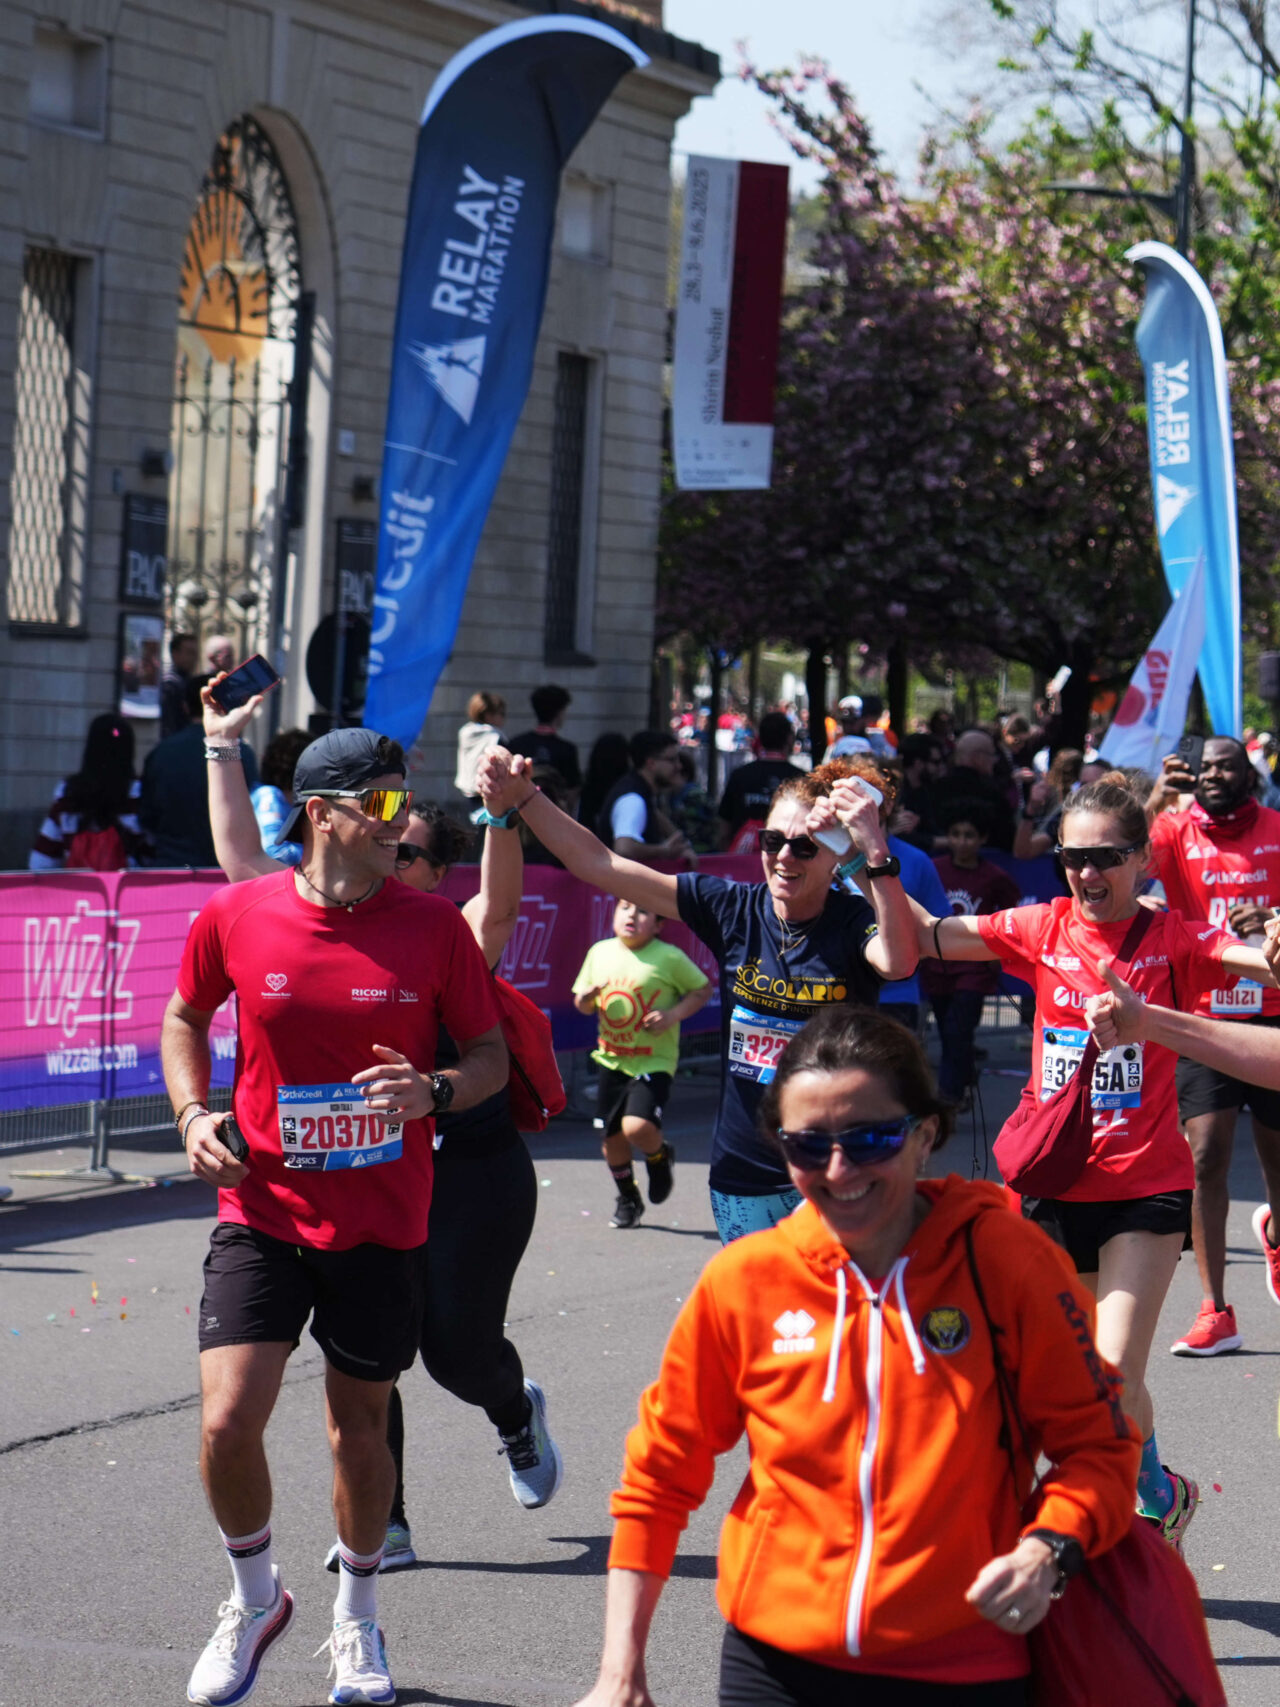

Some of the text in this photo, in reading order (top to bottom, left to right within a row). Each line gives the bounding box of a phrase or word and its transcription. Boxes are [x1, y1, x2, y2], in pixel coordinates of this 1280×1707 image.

[431, 163, 500, 317] RELAY
[470, 175, 526, 325] MARATHON
[369, 489, 435, 676] Credit
[1216, 869, 1268, 885] UniCredit
[733, 986, 818, 1015] ESPERIENZE D'INCLU
[47, 1040, 138, 1076] wizzair.com
[745, 1034, 788, 1066] 322
[1055, 1058, 1125, 1092] 325A
[296, 1156, 317, 1165] asics
